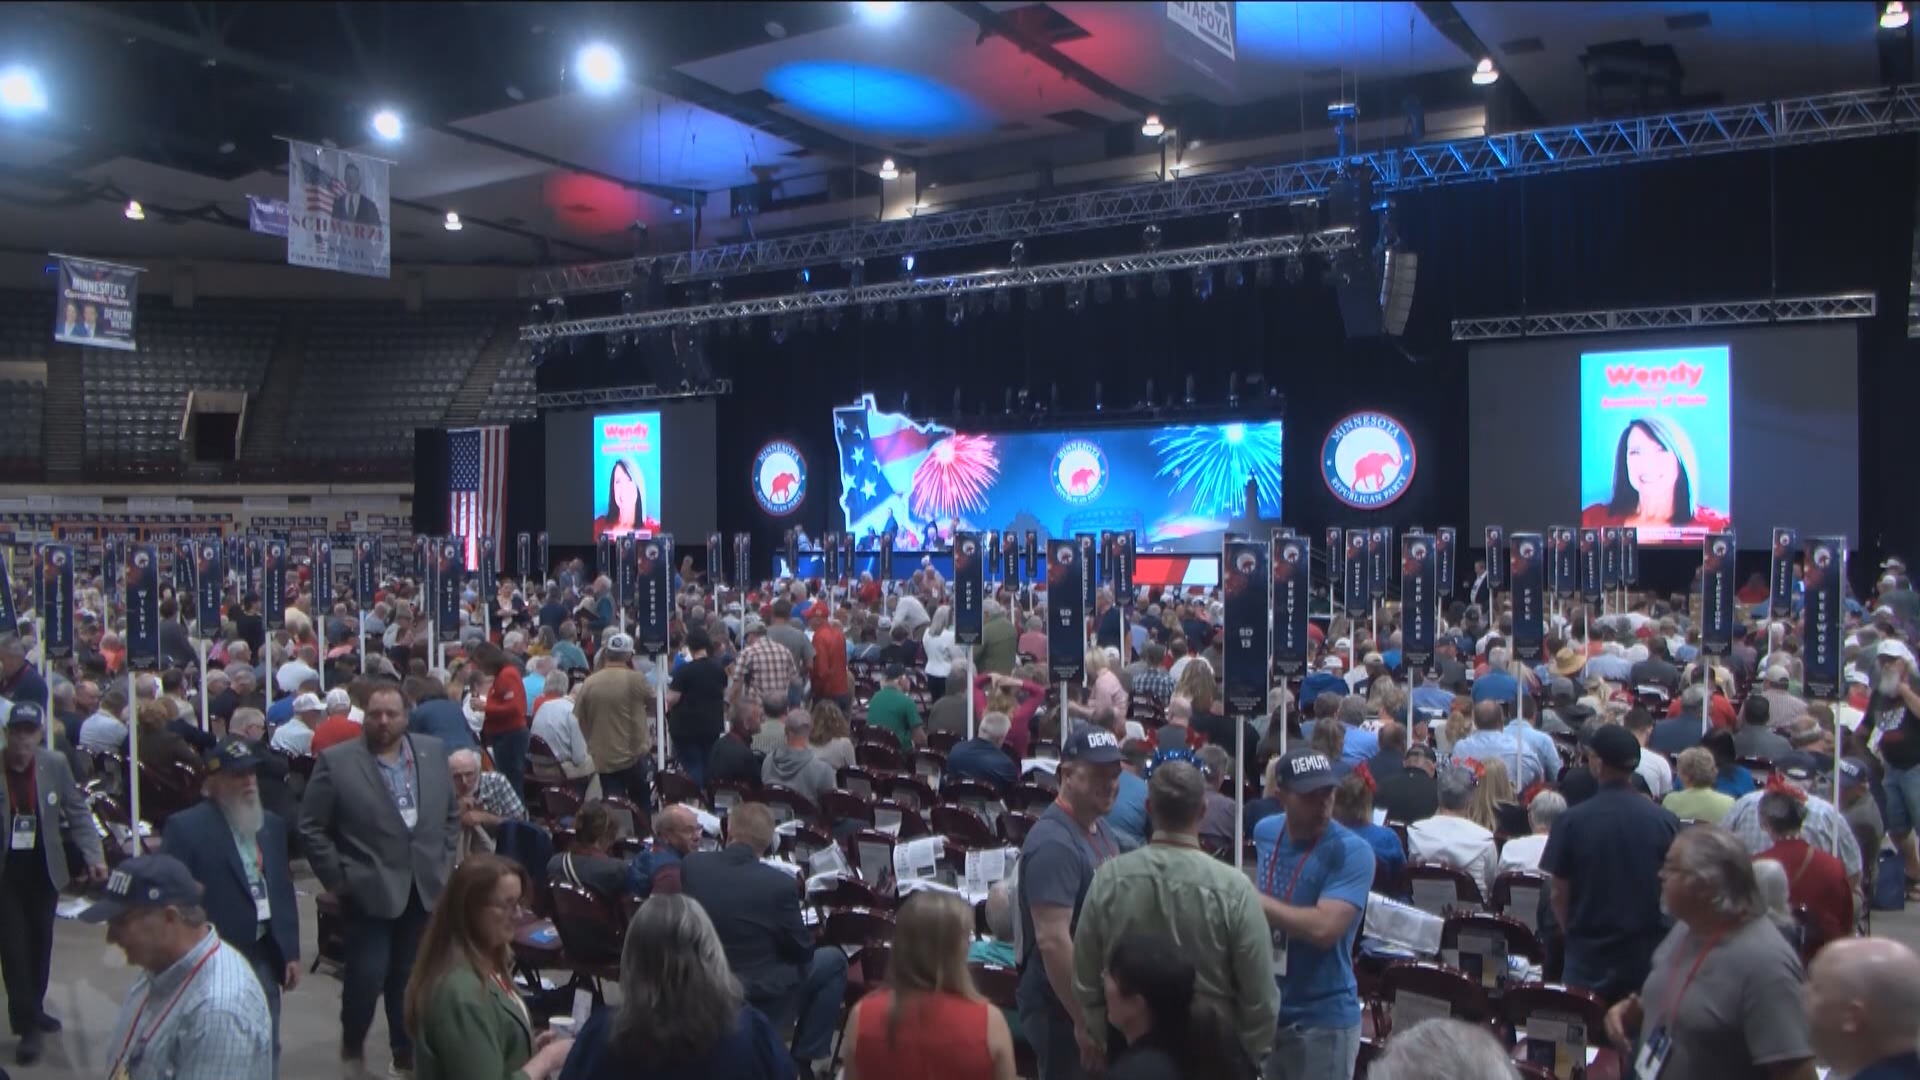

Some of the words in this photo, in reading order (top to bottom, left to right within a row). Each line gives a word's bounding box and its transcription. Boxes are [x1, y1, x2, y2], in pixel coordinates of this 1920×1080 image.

[72, 276, 127, 299] MINNESOTA'S
[104, 308, 132, 322] DEMUTH
[1606, 361, 1704, 388] Wendy
[604, 423, 648, 440] Wendy
[1332, 415, 1400, 442] MINNESOTA
[758, 443, 799, 464] MINNESOTA
[1331, 477, 1381, 504] REPUBLICAN
[1383, 474, 1406, 498] PARTY
[757, 490, 788, 512] REPUBLICAN
[787, 490, 802, 508] PARTY
[649, 580, 657, 625] ROSEAU
[1059, 608, 1072, 617] SD
[138, 590, 147, 639] WILKIN
[1239, 627, 1253, 637] SD
[1816, 591, 1827, 664] REDWOOD
